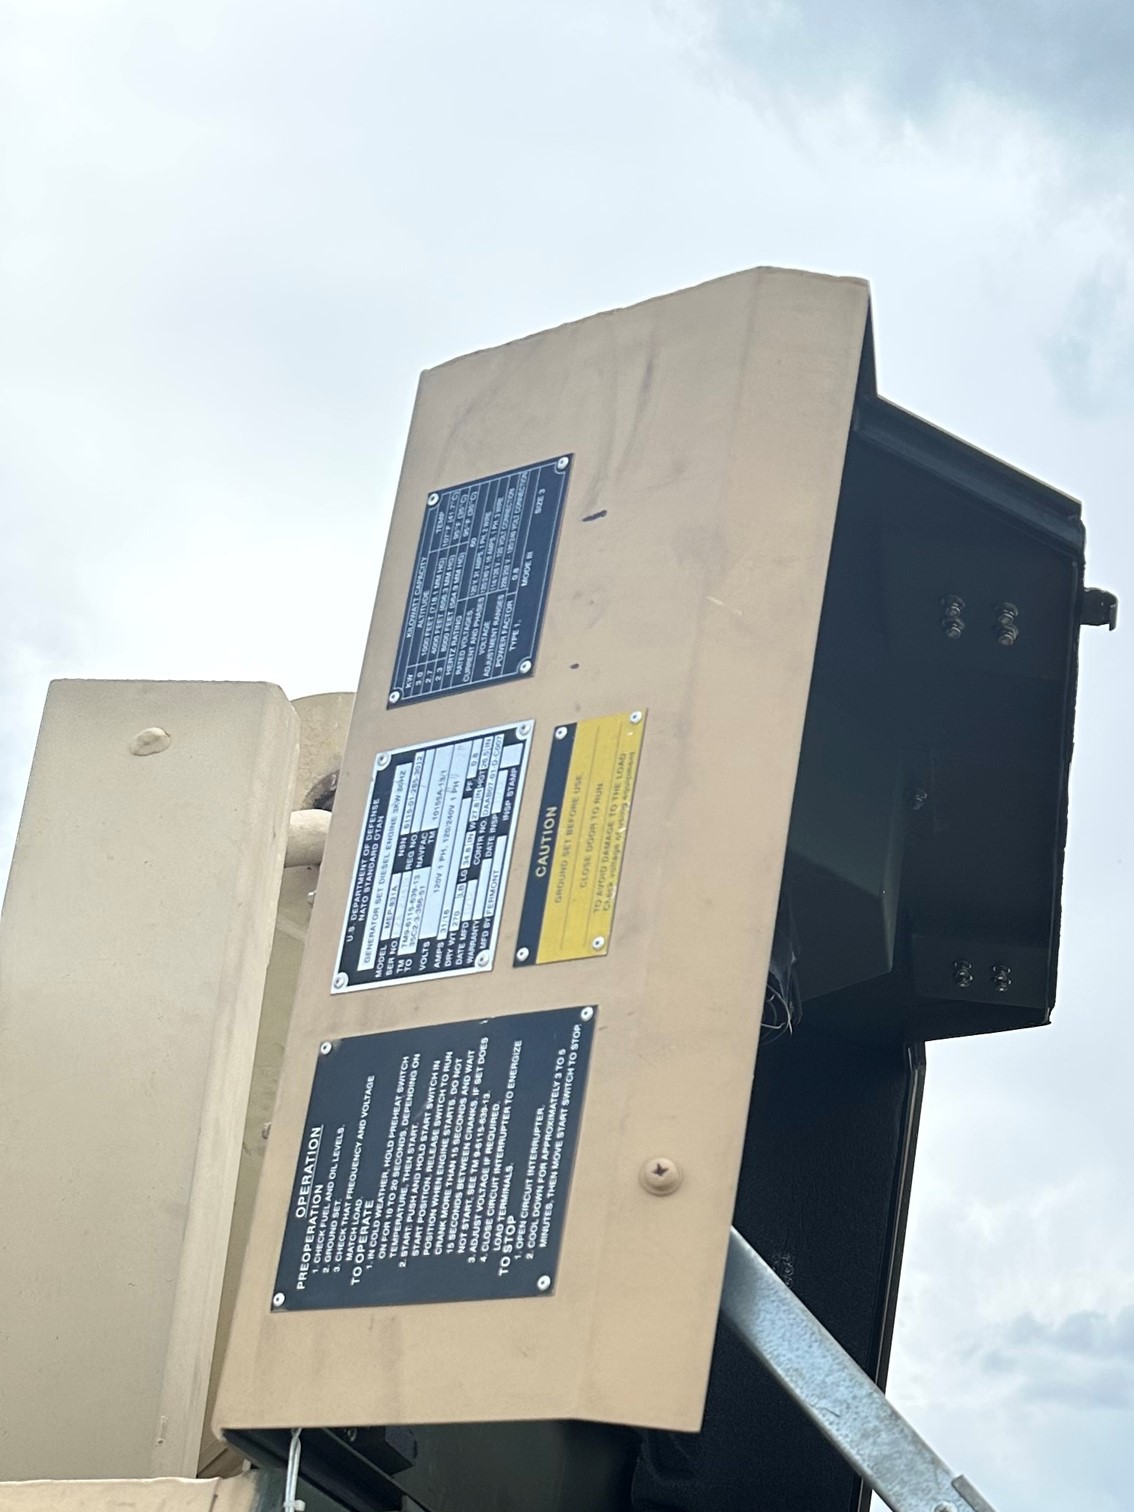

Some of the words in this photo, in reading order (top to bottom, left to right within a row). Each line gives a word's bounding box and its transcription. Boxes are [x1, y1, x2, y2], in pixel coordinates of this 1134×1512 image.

[405, 595, 420, 638] KILOWATT
[413, 555, 428, 595] CAPACITY
[416, 589, 430, 629] ALTITUDE
[372, 814, 384, 841] OTAN
[384, 815, 398, 851] ENGINE
[565, 796, 579, 836] BEFORE
[534, 805, 557, 877] CAUTION
[561, 838, 572, 857] SET
[584, 822, 597, 852] DOOR
[350, 857, 369, 921] DEPARTMENT
[365, 797, 380, 841] DEFENSE
[363, 842, 379, 893] STANDARD
[377, 852, 391, 885] DIESEL
[579, 855, 592, 888] CLOSE
[374, 886, 385, 905] SET
[554, 859, 569, 903] GROUND
[357, 894, 370, 921] NATO
[363, 906, 381, 963] GENERATOR
[374, 944, 388, 978] MODEL
[418, 940, 431, 971] VOLTS
[433, 940, 445, 969] AMPS
[294, 1125, 321, 1218] OPERATION
[328, 1163, 338, 1179] OIL
[324, 1180, 335, 1201] AND
[475, 1166, 490, 1212] VOLTAGE
[519, 1177, 534, 1218] CIRCUIT
[320, 1202, 332, 1228] FUEL
[354, 1199, 375, 1263] OPERATE
[296, 1183, 323, 1289] PREOPERATION
[313, 1229, 327, 1263] CHECK
[323, 1219, 338, 1263] GROUND
[345, 1226, 358, 1261] MATCH
[468, 1213, 483, 1252] ADJUST
[492, 1222, 505, 1250] LOAD
[502, 1214, 518, 1253] STOP
[515, 1219, 528, 1249] OPEN
[350, 1265, 363, 1285] TO
[498, 1255, 511, 1276] TO
